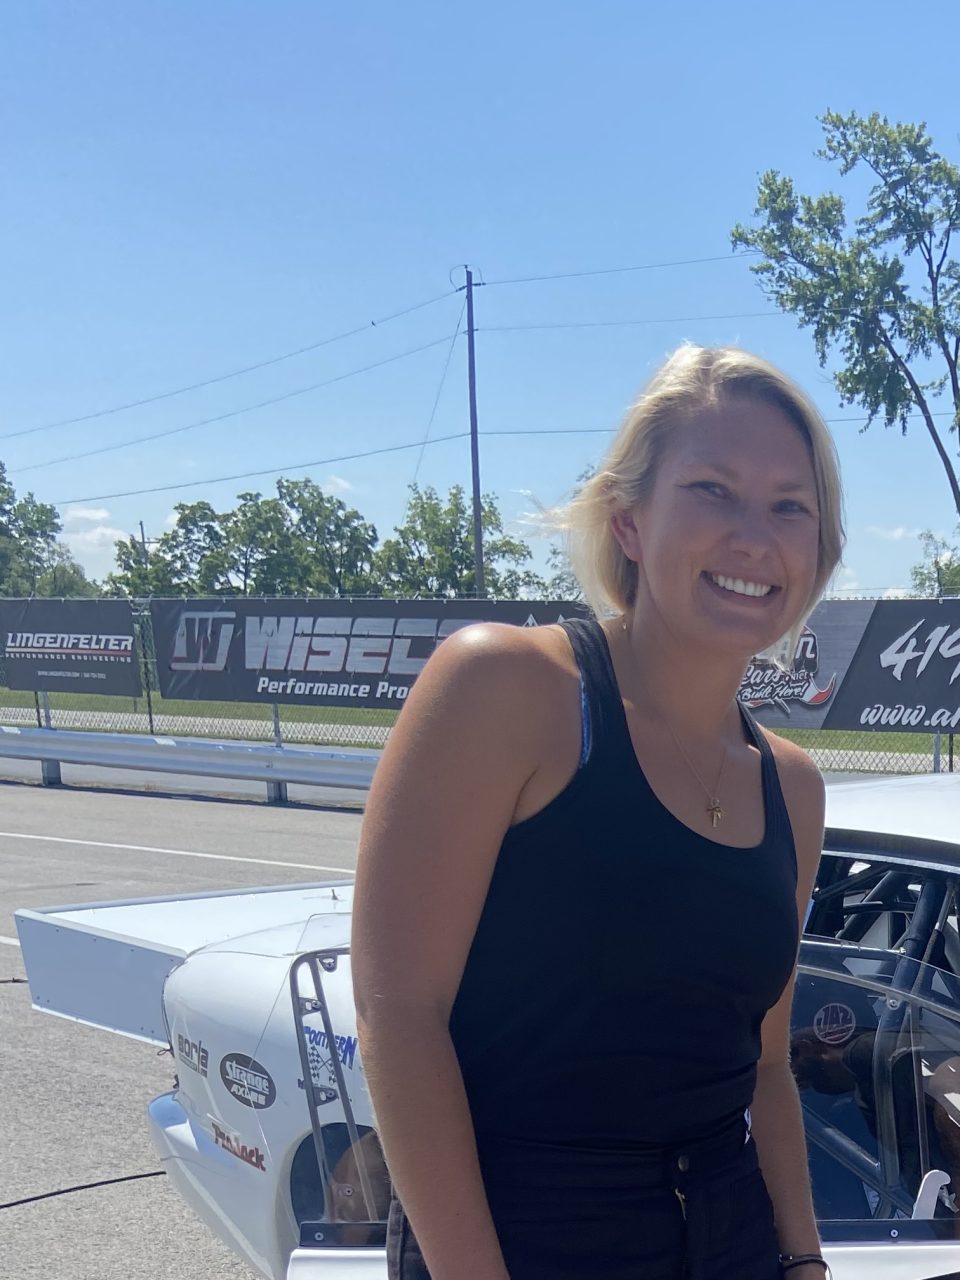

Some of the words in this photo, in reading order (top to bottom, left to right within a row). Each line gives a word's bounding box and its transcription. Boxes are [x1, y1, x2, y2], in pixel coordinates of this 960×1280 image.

[6, 632, 134, 650] LINGENFELTER
[245, 616, 460, 674] WISEC
[257, 677, 370, 698] Performance
